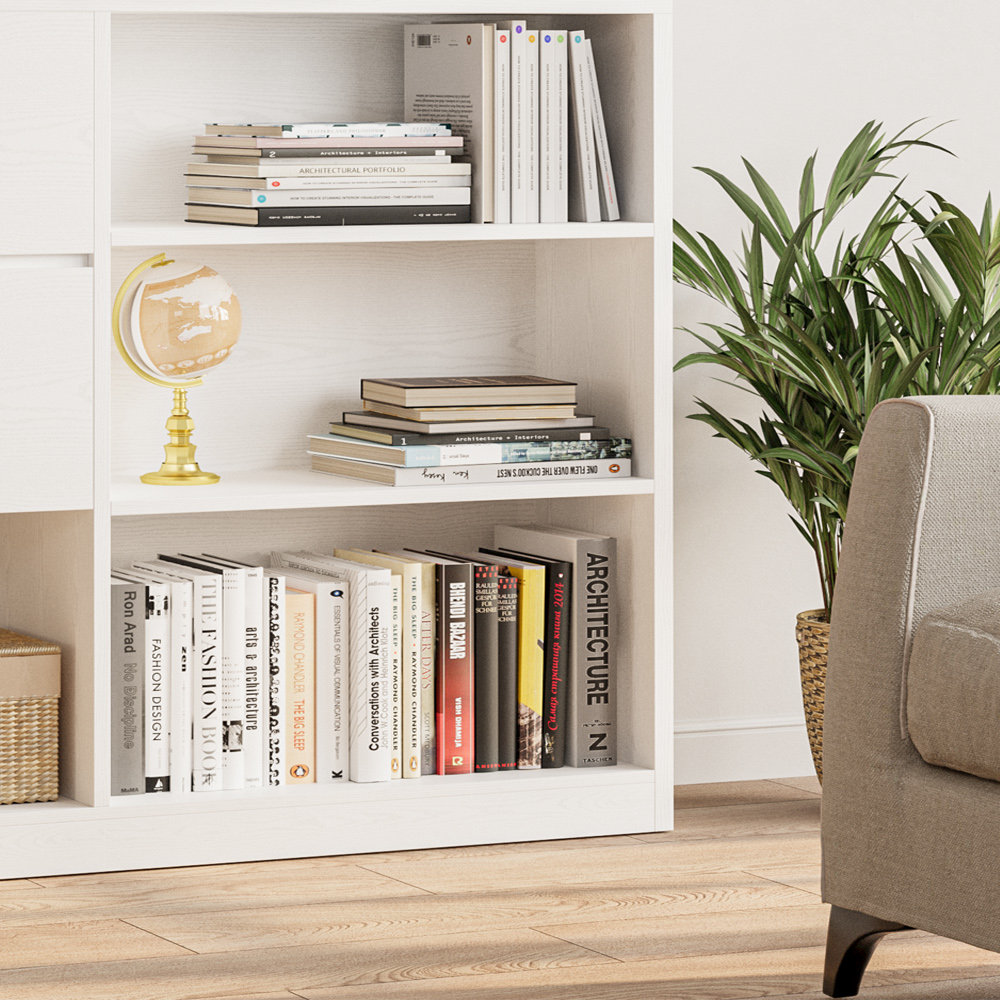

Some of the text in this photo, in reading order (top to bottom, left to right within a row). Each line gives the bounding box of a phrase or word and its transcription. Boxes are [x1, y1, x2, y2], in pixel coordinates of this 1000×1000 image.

[299, 166, 406, 174] ARCHITECTURAL PORTFOLIO
[401, 437, 407, 446] 1
[497, 465, 598, 478] ONE FLEW OVER THE CUCKOO'S NEST
[421, 468, 469, 482] Ken Kesey
[246, 627, 259, 648] arts
[334, 644, 341, 653] OF
[449, 582, 466, 660] BHENDI BAZAAR
[586, 552, 609, 705] ARCHITECTURE
[121, 591, 137, 750] Ron Arad No Discipline
[202, 579, 217, 785] THE FASHION BOOK
[293, 612, 305, 751] RAYMOND CHANDLER THE BIG SLEEP
[369, 607, 380, 751] Conversations with Architects
[380, 627, 388, 749] John Cook and Heinrich Klotz
[421, 657, 431, 689] DAYS
[547, 581, 564, 731] Самая страшная книга 2014
[151, 639, 162, 741] FASHION DESIGN
[246, 666, 260, 731] architecture
[454, 716, 462, 748] DHAMIJA
[332, 770, 343, 779] K
